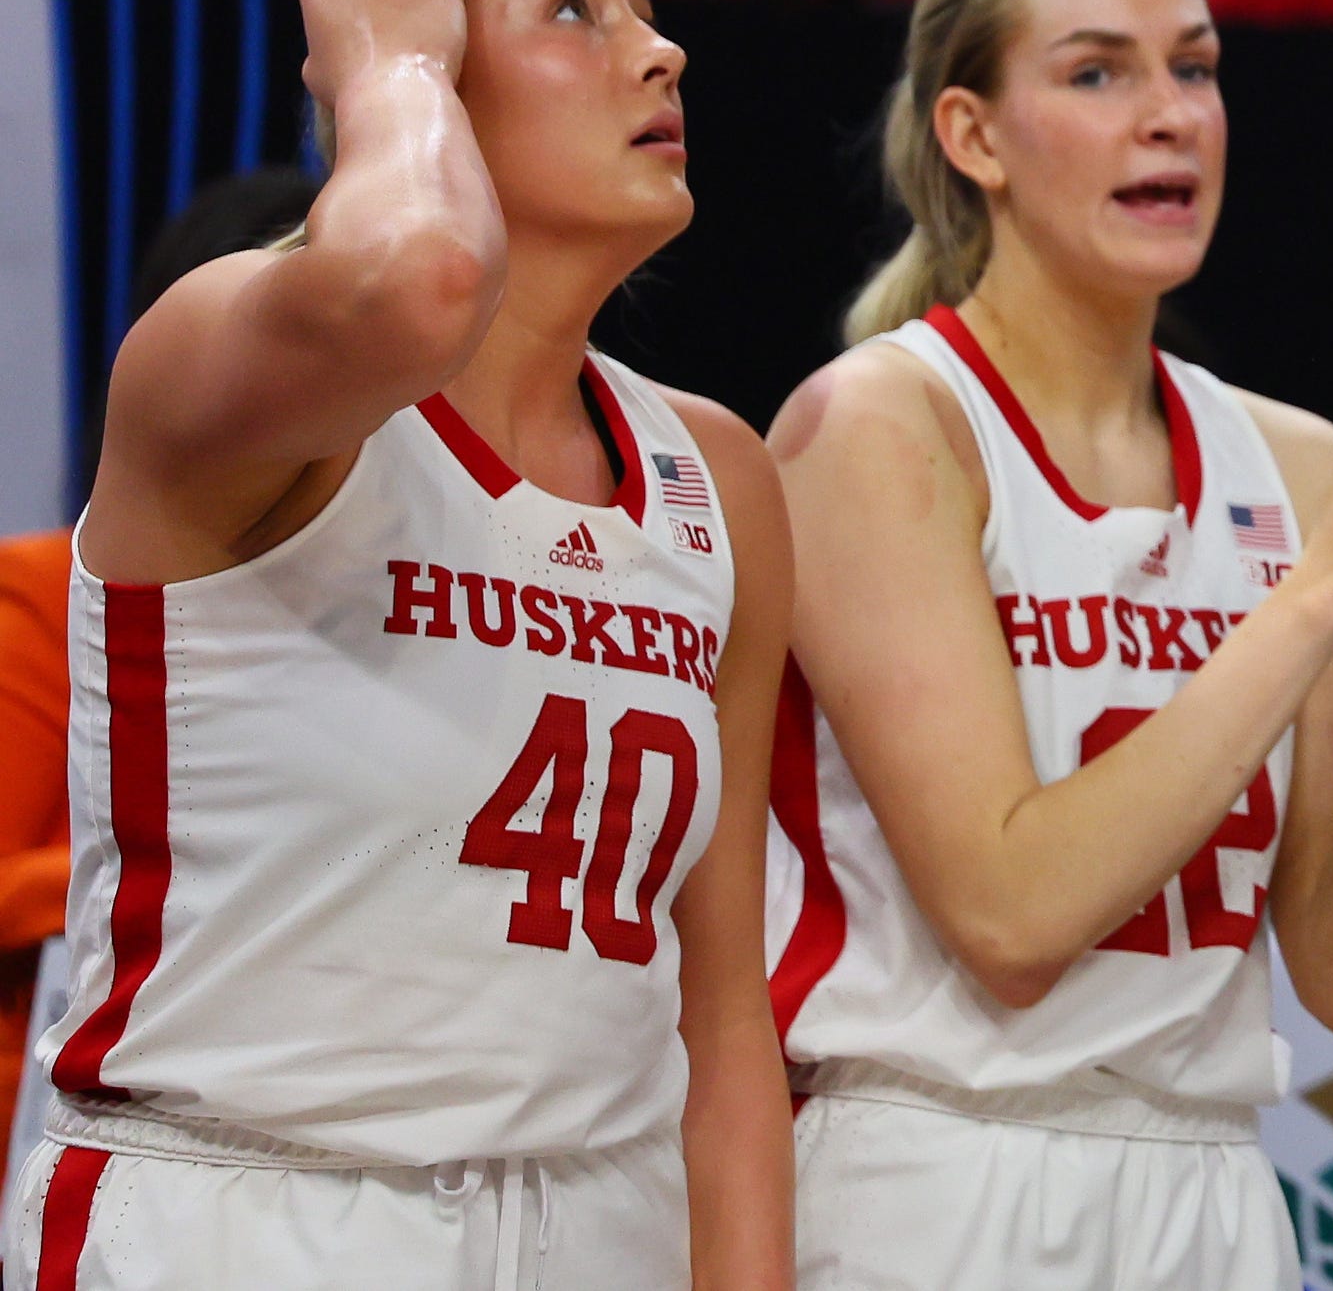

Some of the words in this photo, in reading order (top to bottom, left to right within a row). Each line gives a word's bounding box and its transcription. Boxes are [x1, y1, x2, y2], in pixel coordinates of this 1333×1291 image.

[548, 548, 604, 573] adidas
[383, 559, 718, 693] HUSKERS
[996, 593, 1248, 671] HUSKE
[458, 693, 699, 967] 40
